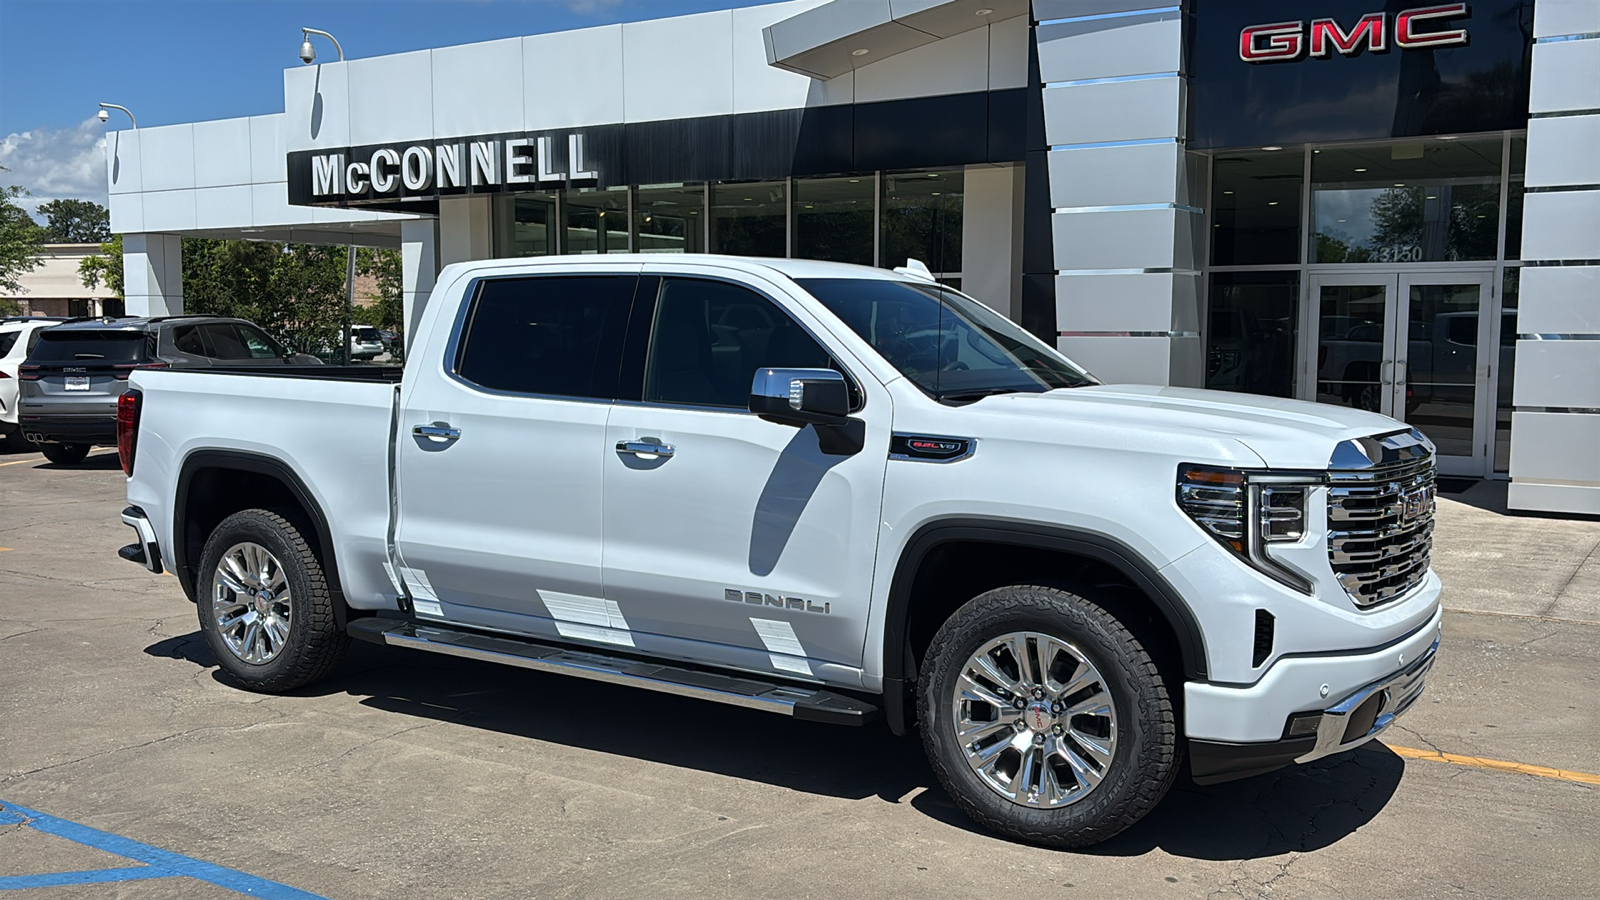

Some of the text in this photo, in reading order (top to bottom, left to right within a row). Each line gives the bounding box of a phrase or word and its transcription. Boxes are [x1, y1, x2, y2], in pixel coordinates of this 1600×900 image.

[1239, 2, 1467, 62] GMC
[311, 133, 598, 196] McCONNELL
[1380, 246, 1423, 261] 3150
[724, 588, 830, 614] DENALI
[1033, 705, 1043, 728] GMC
